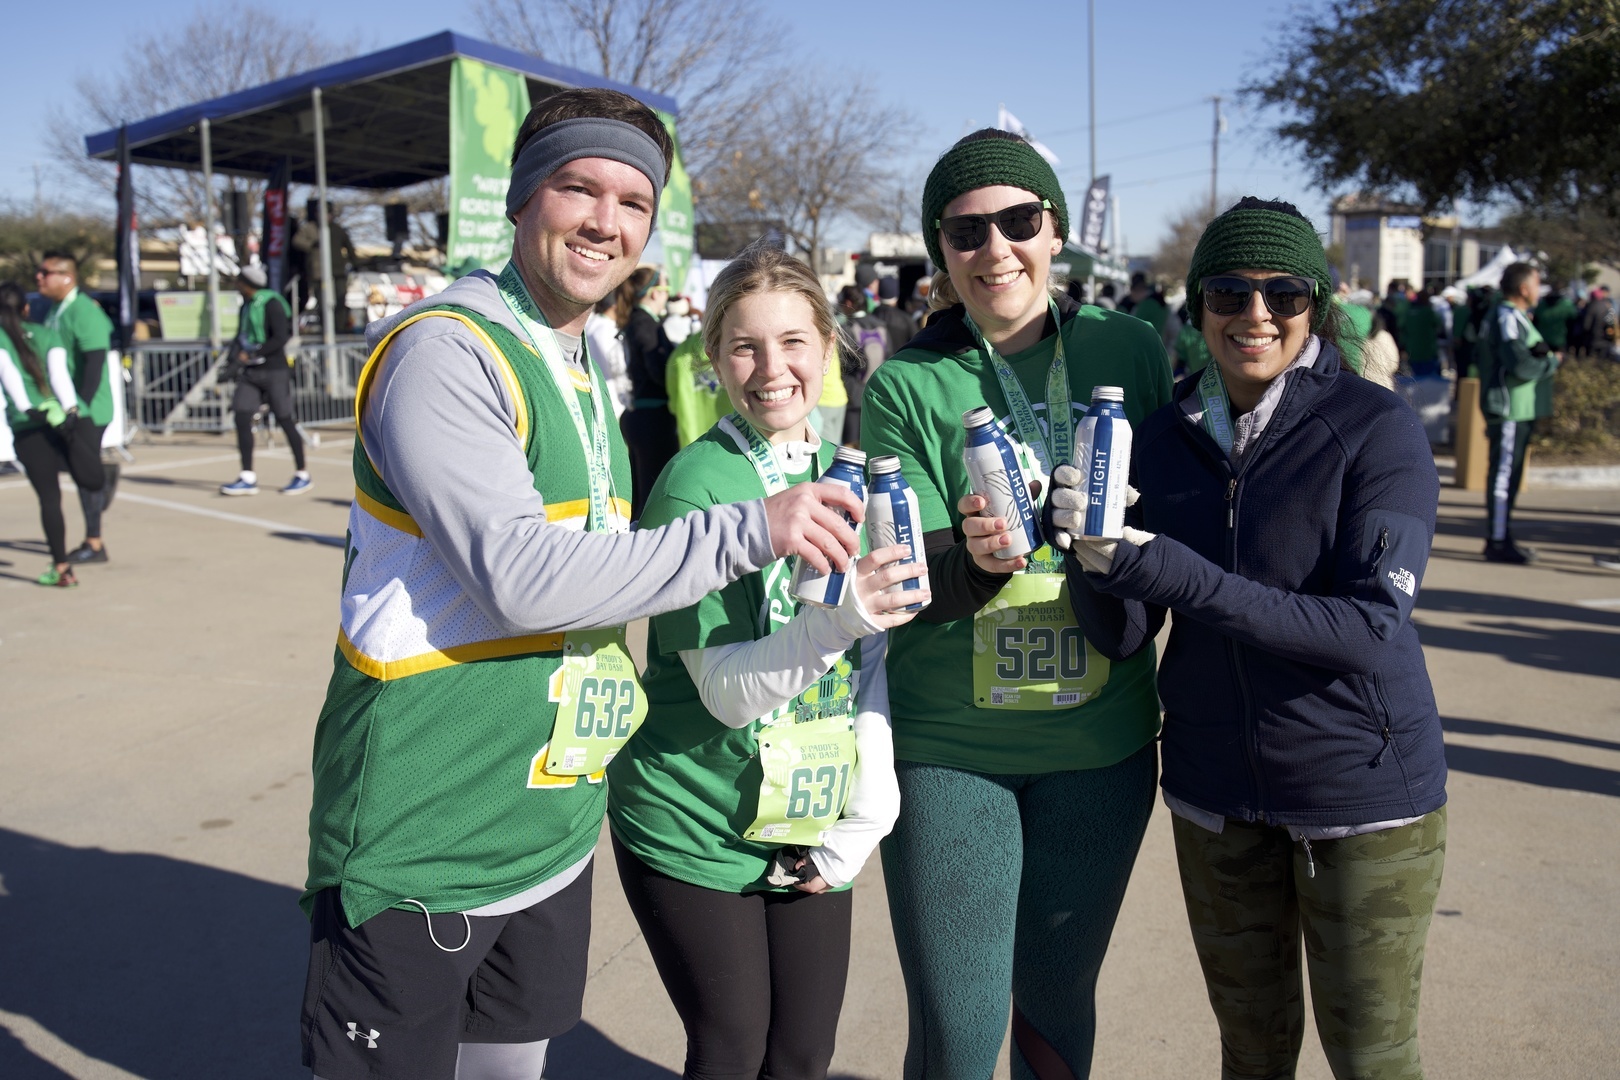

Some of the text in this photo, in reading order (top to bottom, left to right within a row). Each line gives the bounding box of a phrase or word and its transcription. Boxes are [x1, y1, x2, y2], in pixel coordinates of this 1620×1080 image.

[1210, 398, 1222, 422] RUN
[731, 414, 781, 485] FINISHER
[1011, 469, 1033, 521] FLIGHT
[1091, 449, 1107, 505] FLIGHT
[1388, 571, 1409, 585] NORTH
[1394, 580, 1408, 590] FACE
[1400, 568, 1410, 578] THE
[596, 662, 623, 671] DAY DASH
[996, 626, 1087, 680] 520
[574, 676, 635, 738] 632
[809, 743, 839, 752] PADDY'S
[785, 763, 850, 819] 631
